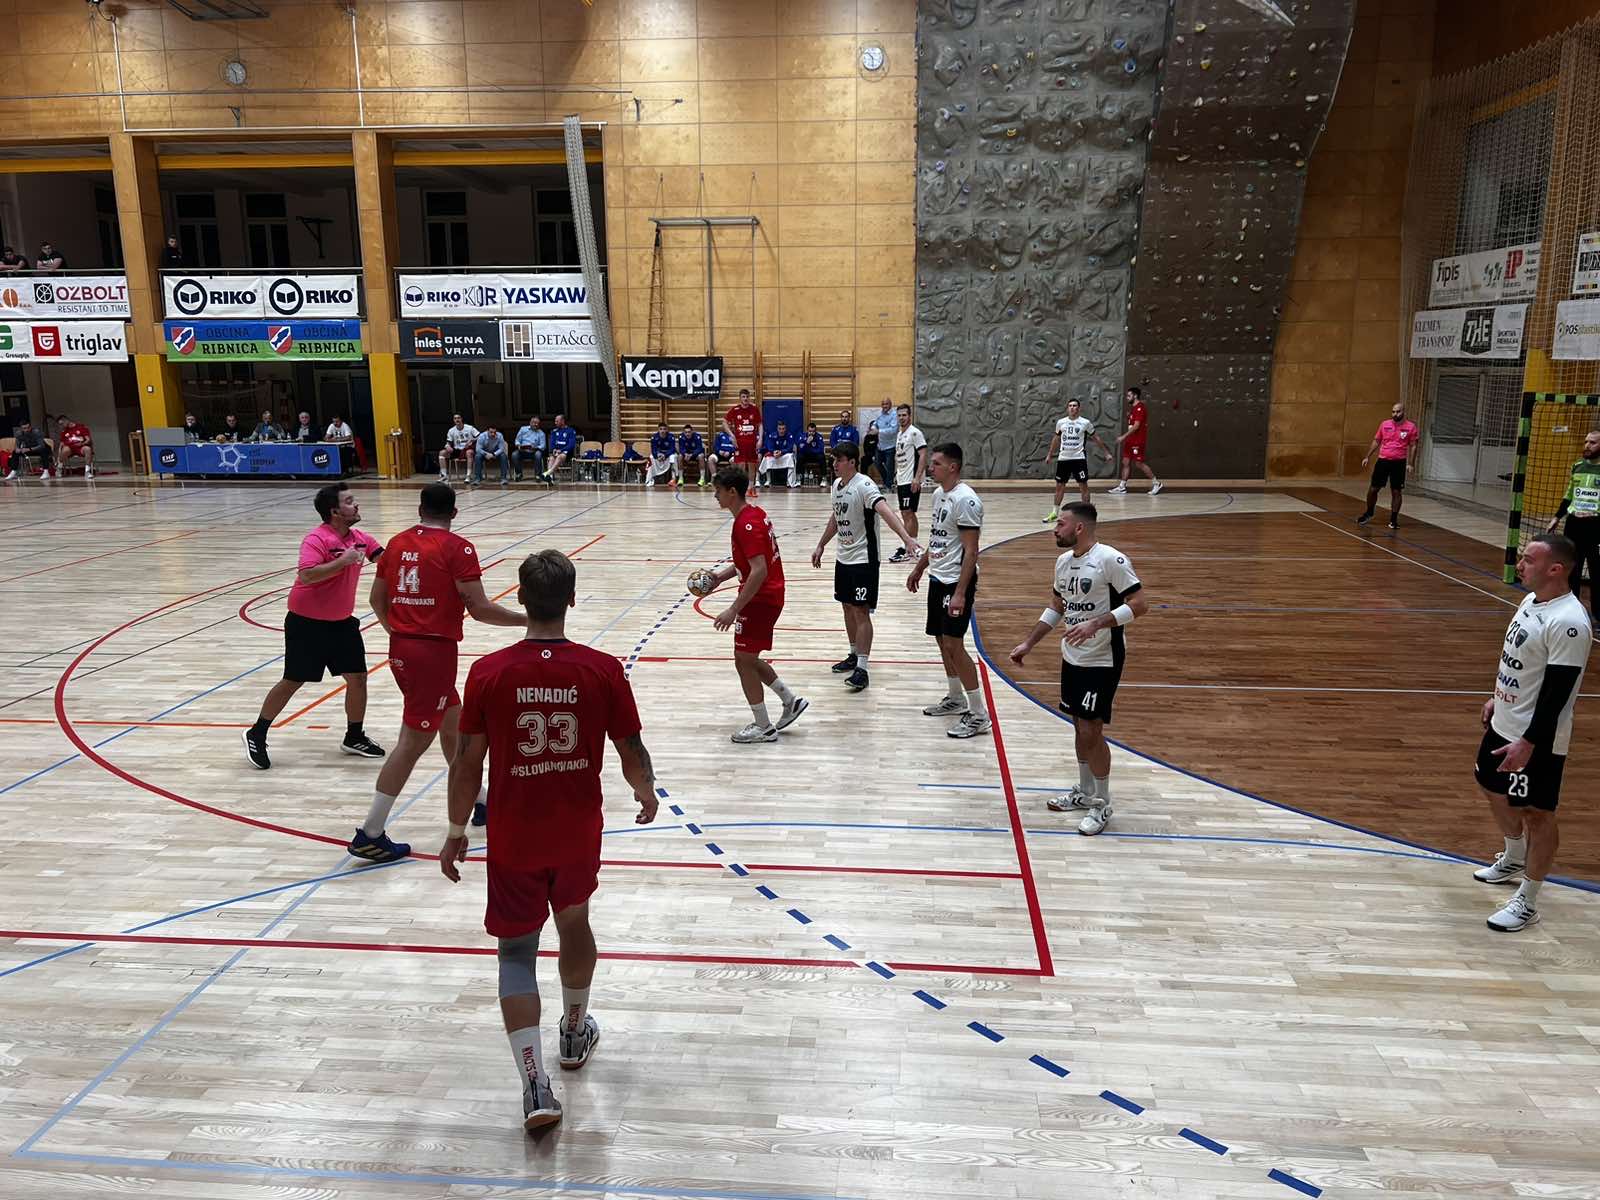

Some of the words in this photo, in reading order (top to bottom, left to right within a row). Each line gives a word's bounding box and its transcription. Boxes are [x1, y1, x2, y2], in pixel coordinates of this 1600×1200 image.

[209, 290, 257, 305] RIKO
[305, 289, 354, 304] RIKO
[427, 291, 461, 303] RIKO
[503, 287, 590, 304] YASKAW
[57, 304, 96, 313] RESISTANT
[99, 304, 109, 313] TO
[111, 304, 129, 313] TIME
[65, 333, 122, 356] triglav
[414, 337, 442, 348] inles
[444, 336, 484, 344] OKNA
[201, 342, 260, 355] RIBNICA
[298, 342, 356, 354] RIBNICA
[445, 347, 485, 355] VRATA
[625, 362, 720, 394] Kempa
[401, 551, 420, 562] POJE
[396, 565, 421, 593] 14
[1068, 576, 1079, 595] 41
[855, 587, 868, 601] 32
[1068, 602, 1096, 612] RIKO
[516, 685, 578, 704] NENADIĆ
[1081, 691, 1098, 712] 41
[516, 711, 579, 757] 33
[1508, 772, 1529, 798] 23
